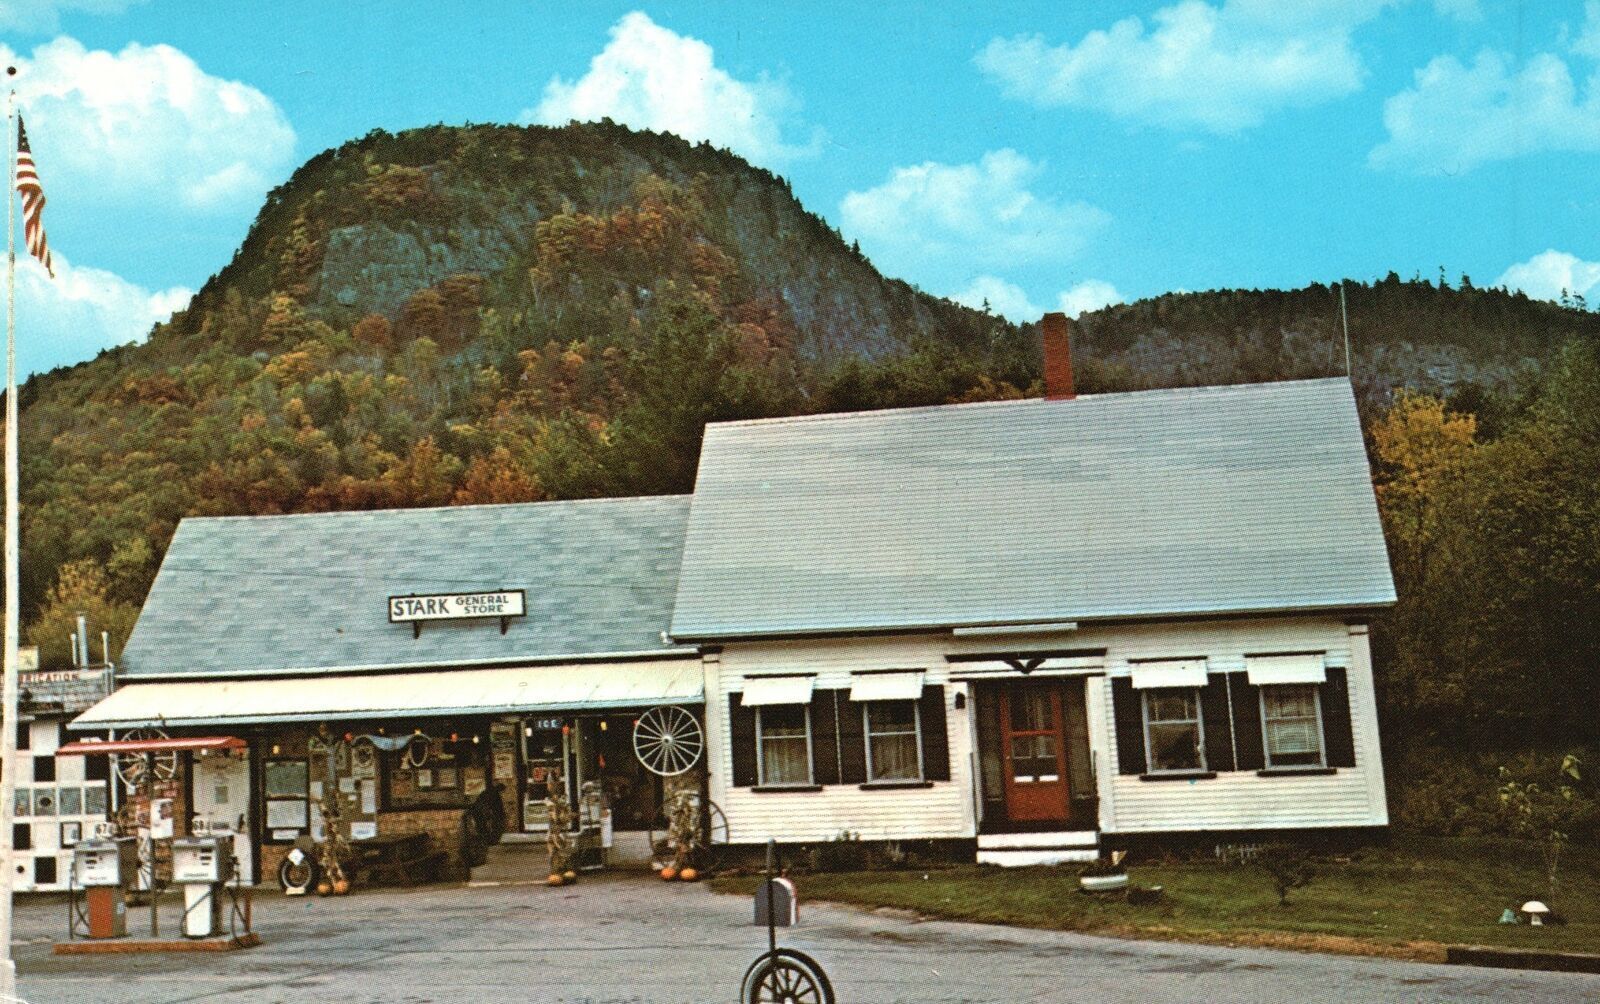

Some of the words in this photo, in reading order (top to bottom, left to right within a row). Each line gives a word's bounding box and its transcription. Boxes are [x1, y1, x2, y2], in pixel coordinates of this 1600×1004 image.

[455, 595, 510, 606] GENERAL
[393, 598, 449, 616] STARK
[464, 604, 504, 614] STORE
